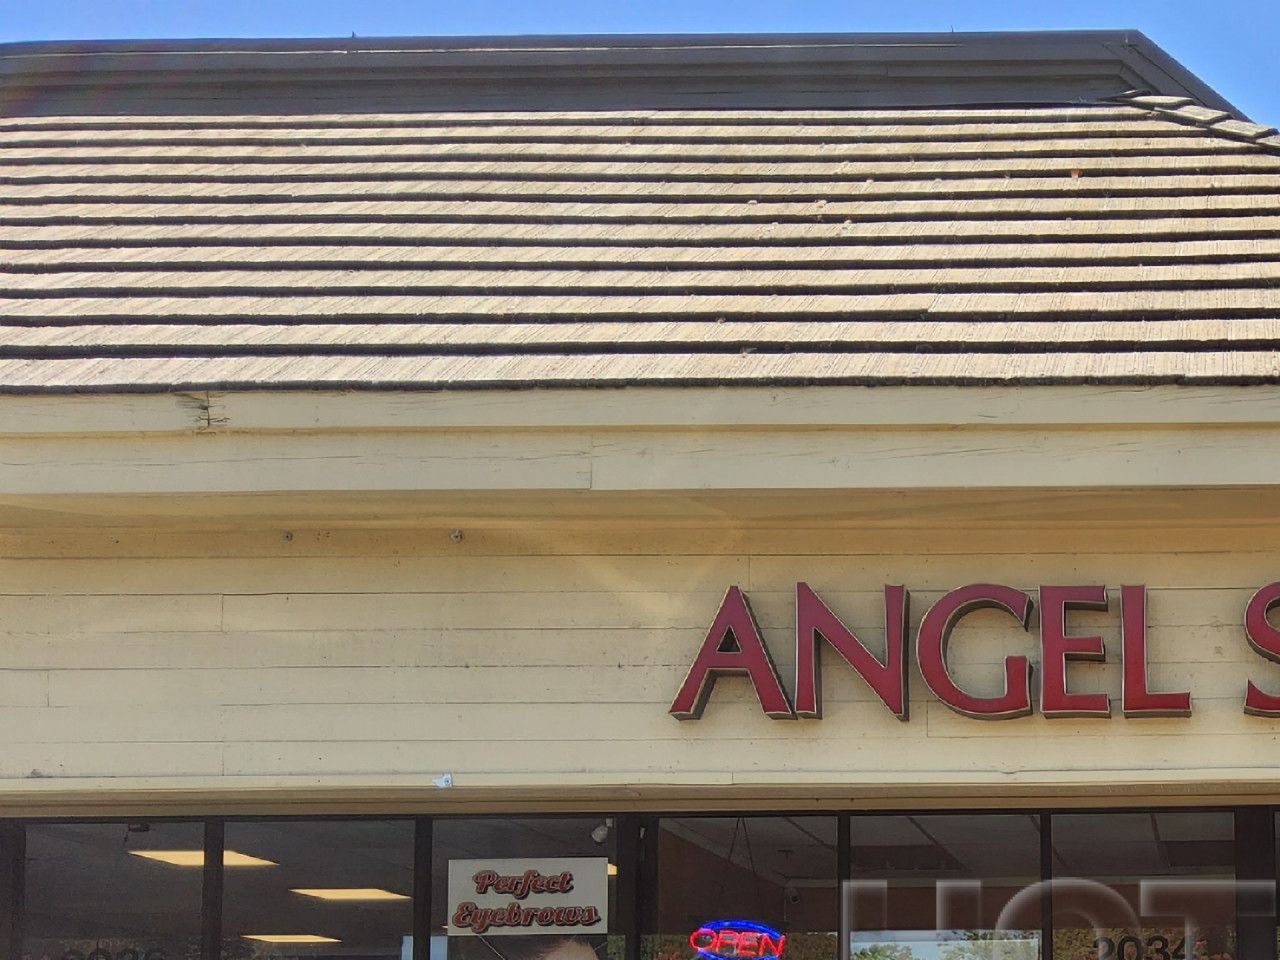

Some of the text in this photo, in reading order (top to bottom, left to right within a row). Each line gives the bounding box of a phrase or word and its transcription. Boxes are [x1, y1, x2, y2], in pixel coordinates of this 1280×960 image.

[668, 580, 1192, 722] ANGEL
[472, 868, 575, 901] Perfect
[452, 900, 602, 935] Eyebrows
[689, 927, 787, 958] OPEN
